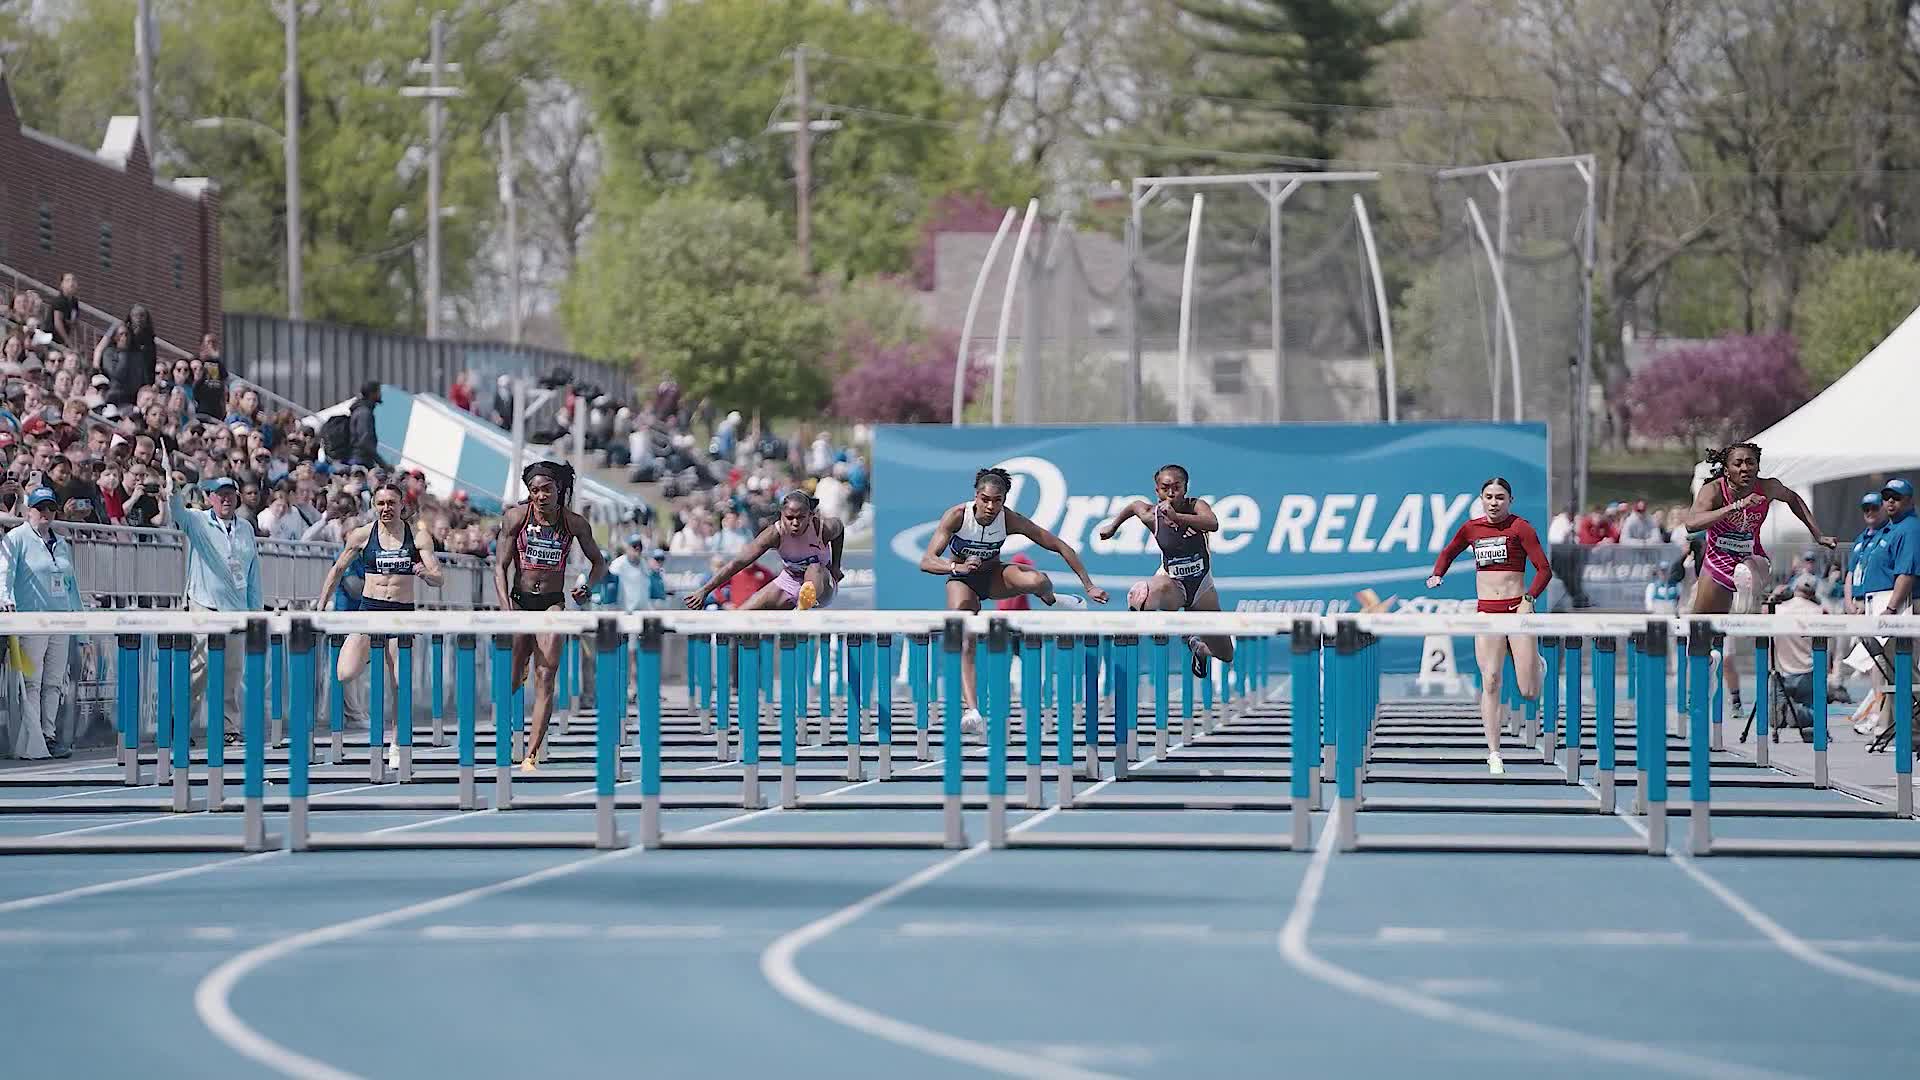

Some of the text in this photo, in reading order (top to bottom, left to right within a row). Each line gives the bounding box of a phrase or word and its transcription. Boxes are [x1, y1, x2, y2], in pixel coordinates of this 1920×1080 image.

[988, 456, 1261, 555] Drae
[1173, 563, 1201, 576] Jones
[1431, 649, 1447, 672] 2
